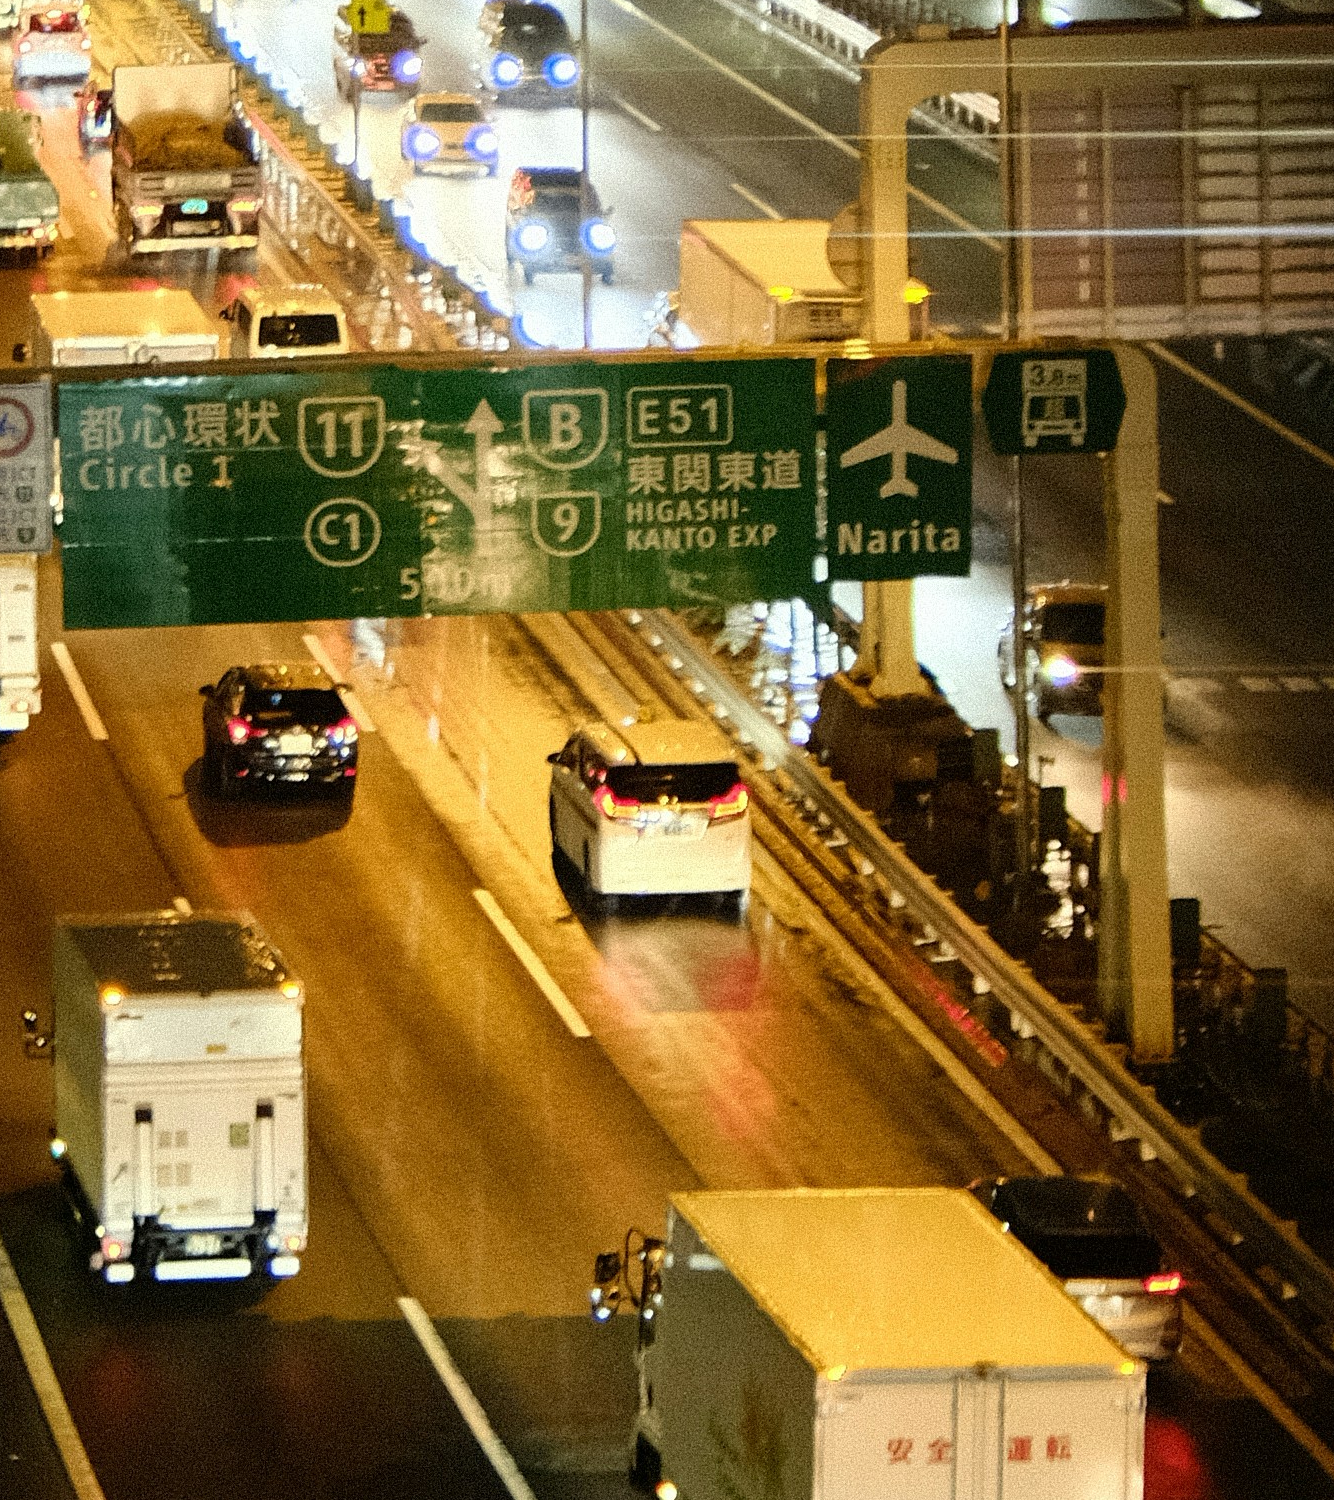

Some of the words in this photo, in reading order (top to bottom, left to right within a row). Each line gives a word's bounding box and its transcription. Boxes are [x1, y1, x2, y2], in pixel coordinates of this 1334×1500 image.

[79, 399, 282, 451] 都心環状
[316, 408, 364, 459] 11
[549, 403, 583, 450] B
[638, 397, 718, 435] E51
[78, 454, 194, 491] Circle
[627, 448, 802, 495] 東関東道
[552, 501, 581, 543] 9
[626, 498, 750, 524] HIGASHI-
[318, 512, 361, 551] C1
[626, 526, 717, 552] KANTO
[727, 523, 778, 548] EXP
[836, 519, 961, 555] Narita
[887, 1434, 1072, 1465] 安全運転
